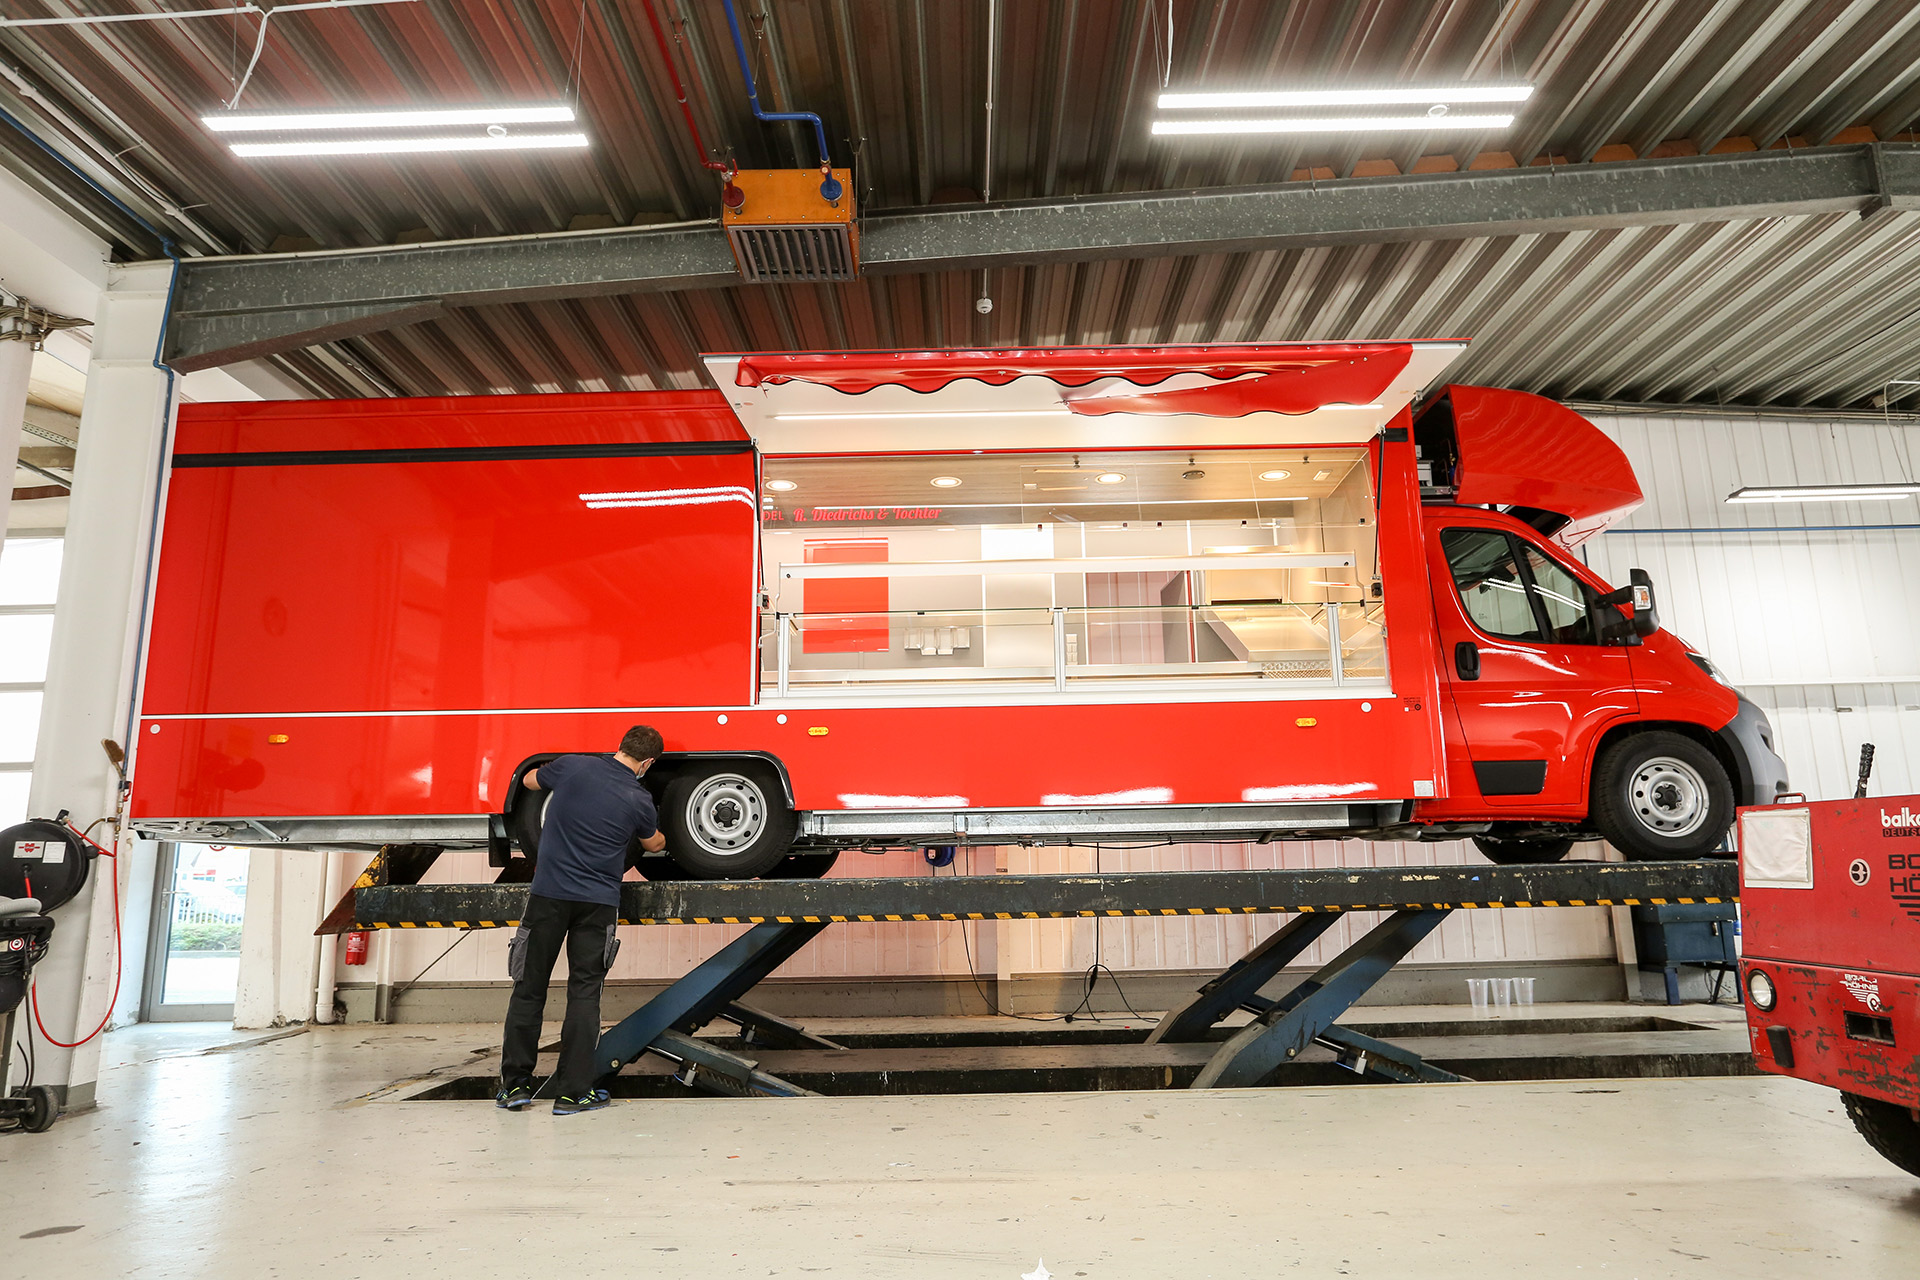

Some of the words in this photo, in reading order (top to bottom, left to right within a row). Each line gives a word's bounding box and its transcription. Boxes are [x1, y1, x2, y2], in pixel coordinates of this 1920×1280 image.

[811, 507, 875, 521] Diedrichs
[876, 507, 889, 520] &
[892, 507, 942, 520] Tochter
